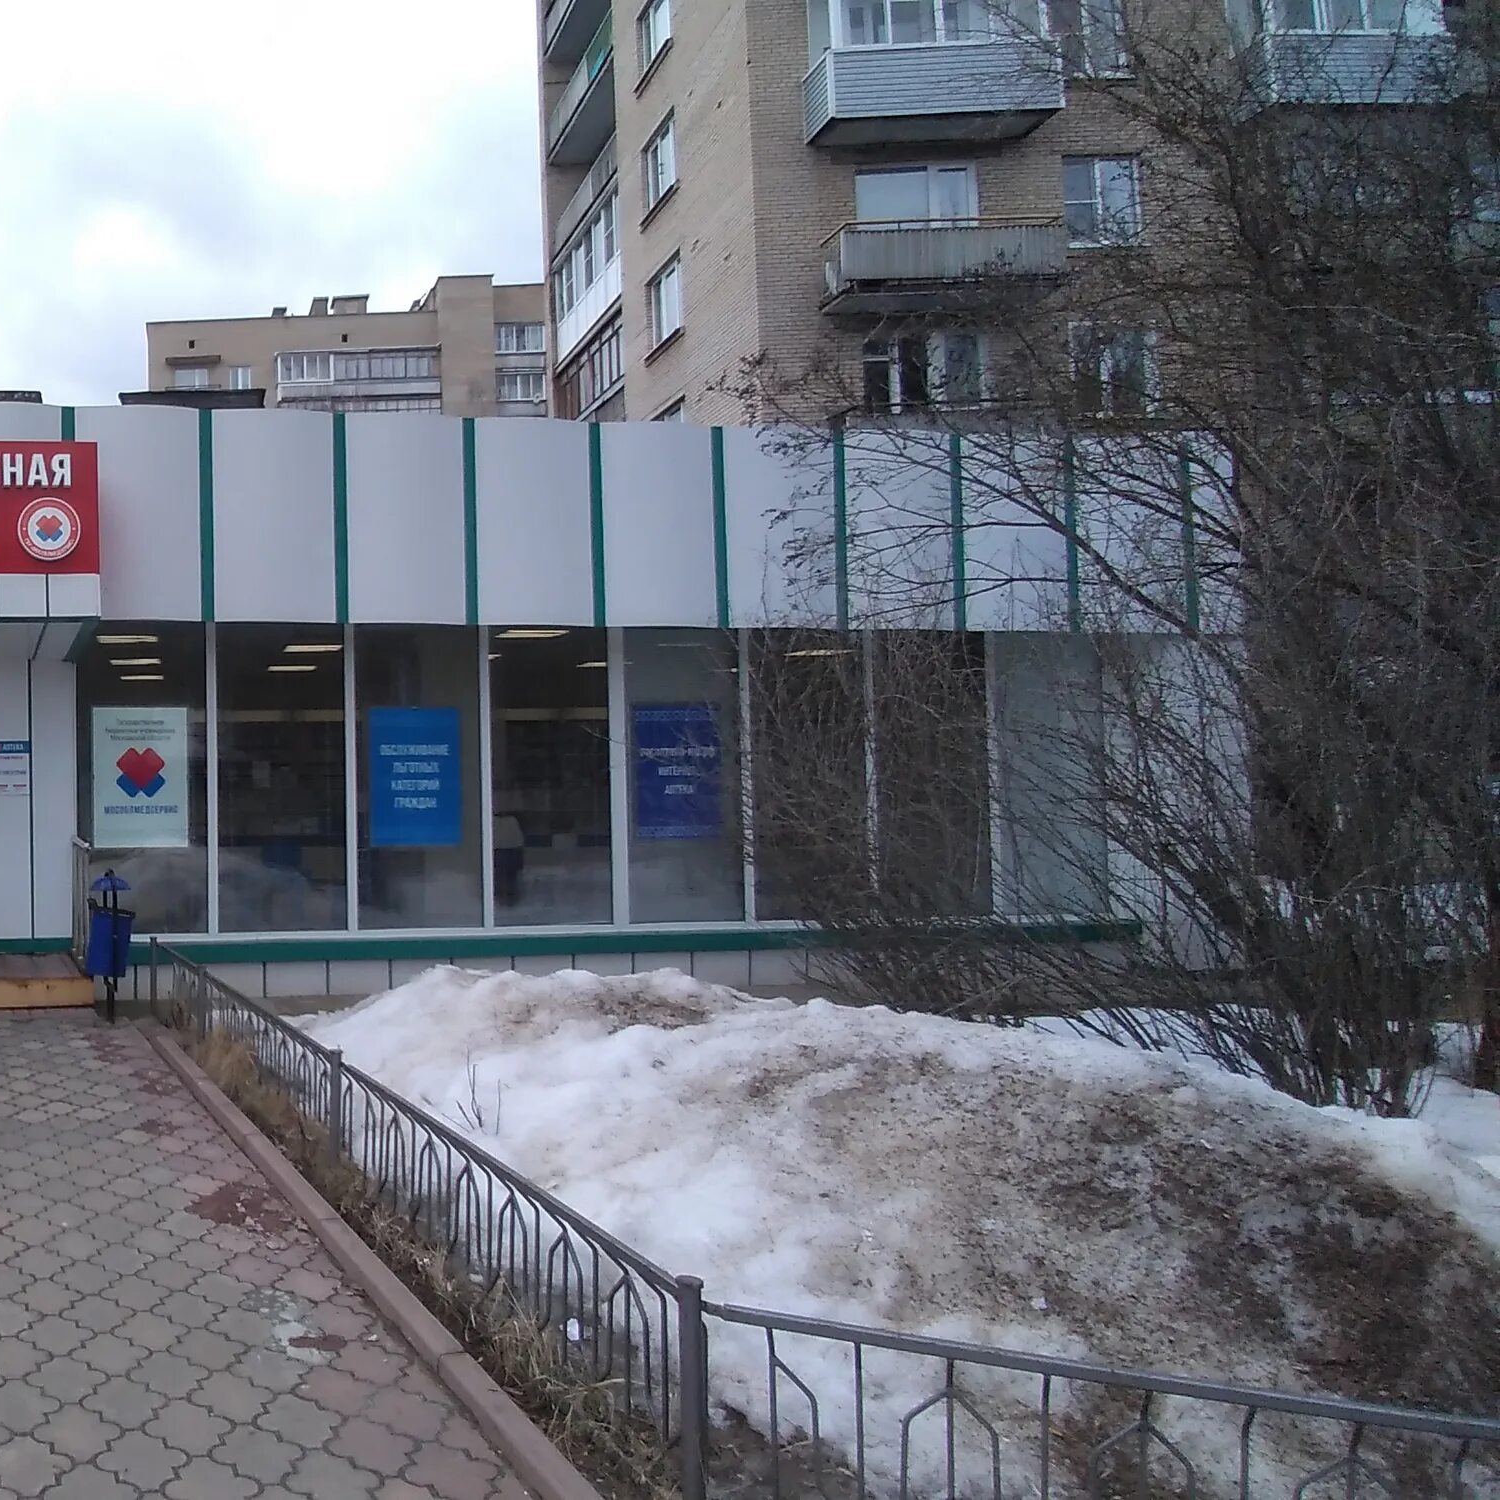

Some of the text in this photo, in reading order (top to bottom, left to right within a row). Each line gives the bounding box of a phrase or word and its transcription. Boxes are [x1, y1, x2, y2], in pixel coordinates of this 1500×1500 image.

[380, 744, 449, 756] ОБСЛУЖИВАНИЕ
[393, 762, 440, 773] ЛЬГОТНЫХ
[391, 778, 440, 791] КАТЕГОРИЙ
[394, 797, 437, 809] ГРАЖДАН
